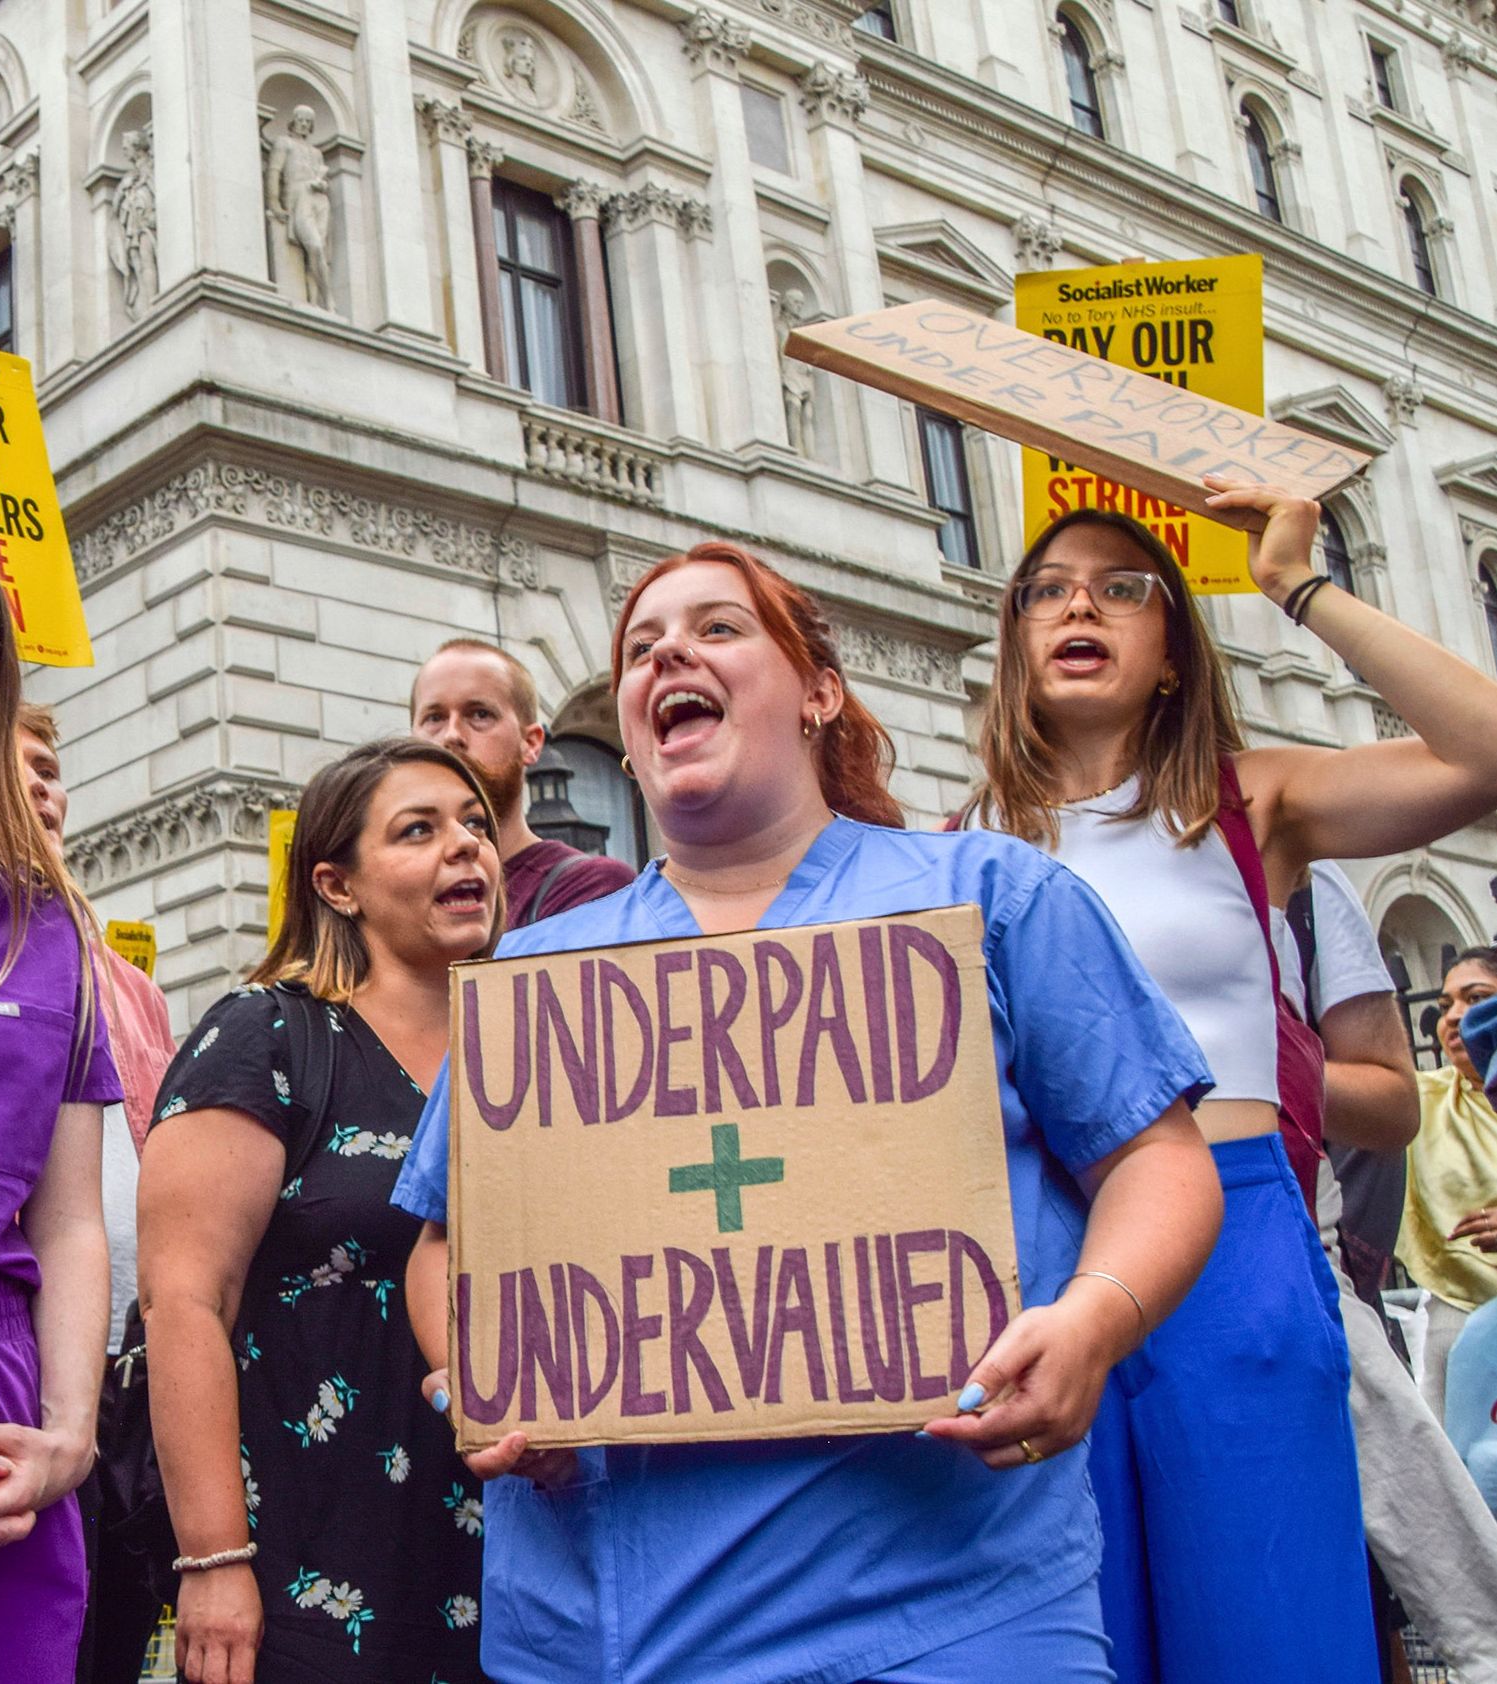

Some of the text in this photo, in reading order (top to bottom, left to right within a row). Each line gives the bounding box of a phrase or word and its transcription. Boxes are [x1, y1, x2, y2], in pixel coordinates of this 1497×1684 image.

[916, 312, 1356, 478] OVERWORKED
[1041, 311, 1063, 325] No
[1067, 311, 1081, 324] to
[1086, 307, 1117, 323] Tory
[1121, 304, 1157, 319] NHS
[1132, 318, 1215, 368] OUR
[463, 924, 962, 1131] UNDERPAID
[456, 1228, 1009, 1425] UNDERVALUED
